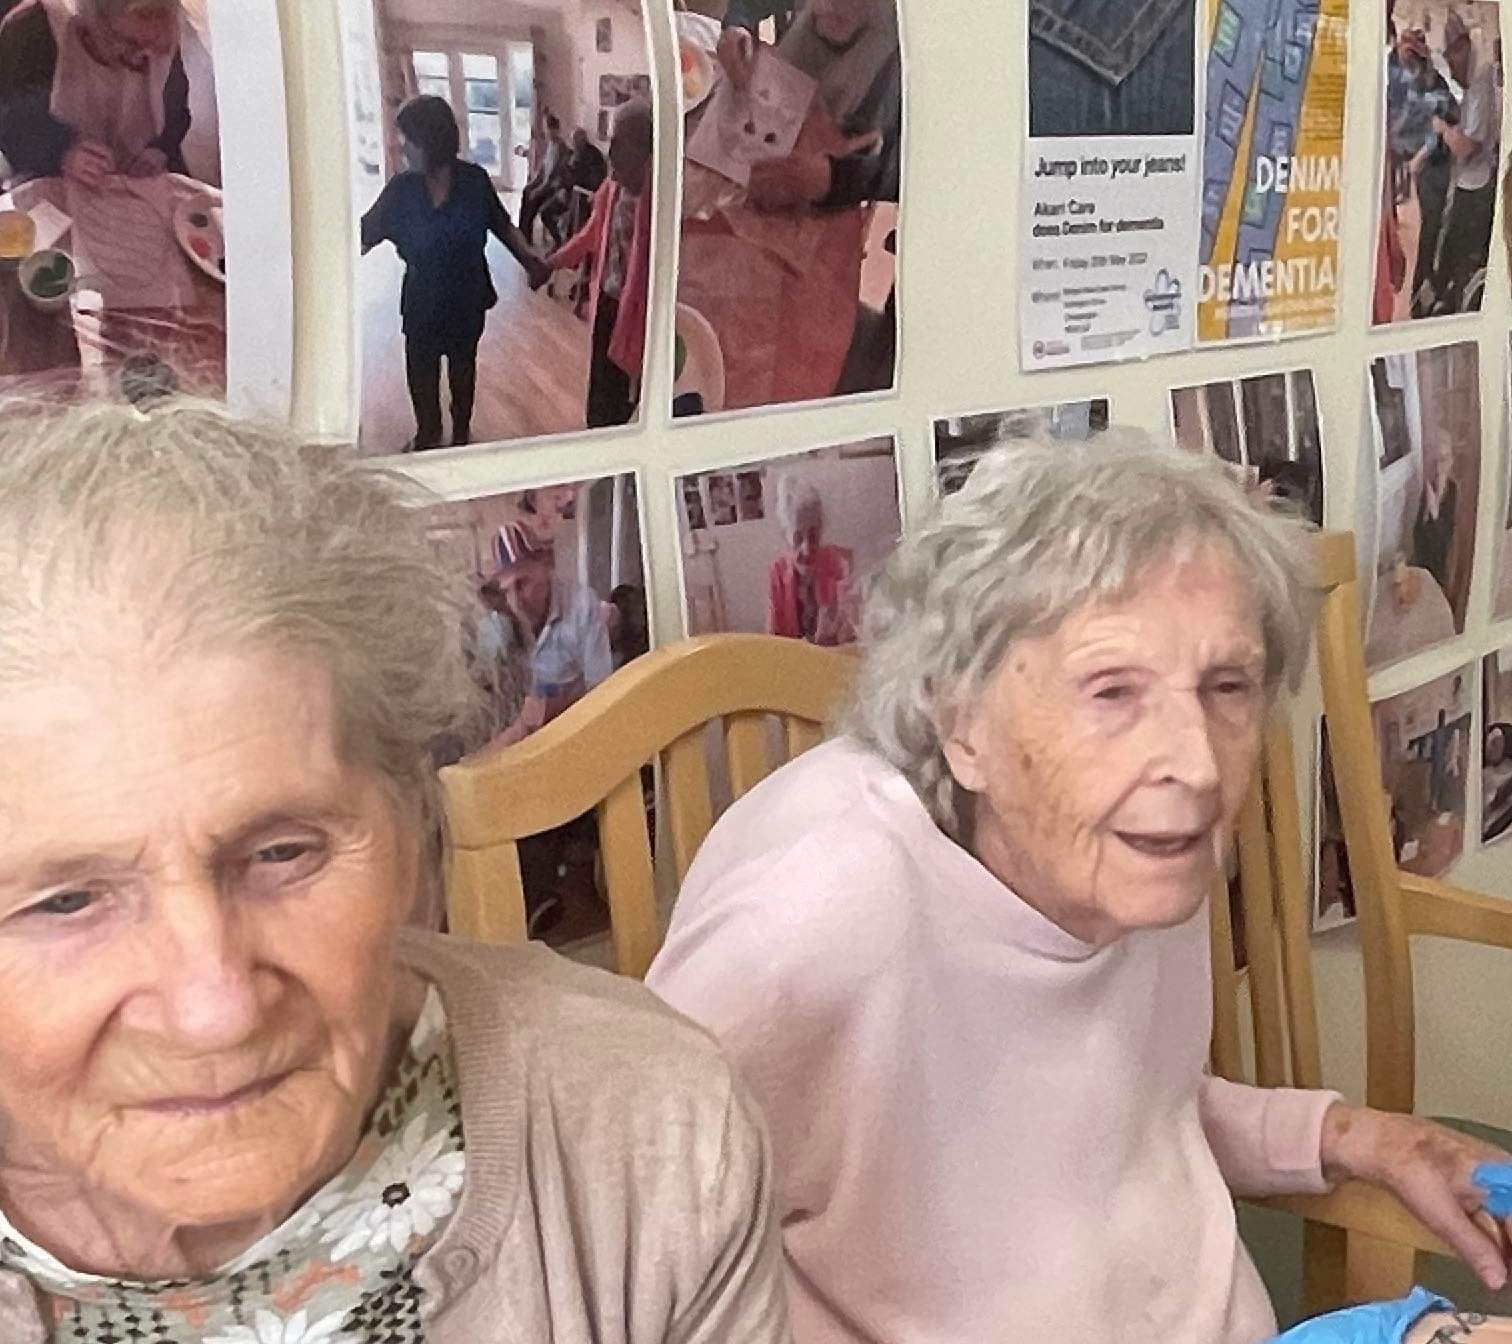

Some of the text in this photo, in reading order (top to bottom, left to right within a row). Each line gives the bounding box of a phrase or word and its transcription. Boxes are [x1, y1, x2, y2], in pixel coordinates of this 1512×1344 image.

[1034, 156, 1077, 180] Jump
[1080, 155, 1108, 176] into
[1110, 158, 1142, 179] your
[1256, 155, 1340, 193] DENIM
[1286, 206, 1339, 244] FOR
[1199, 255, 1335, 304] DEMENTIA
